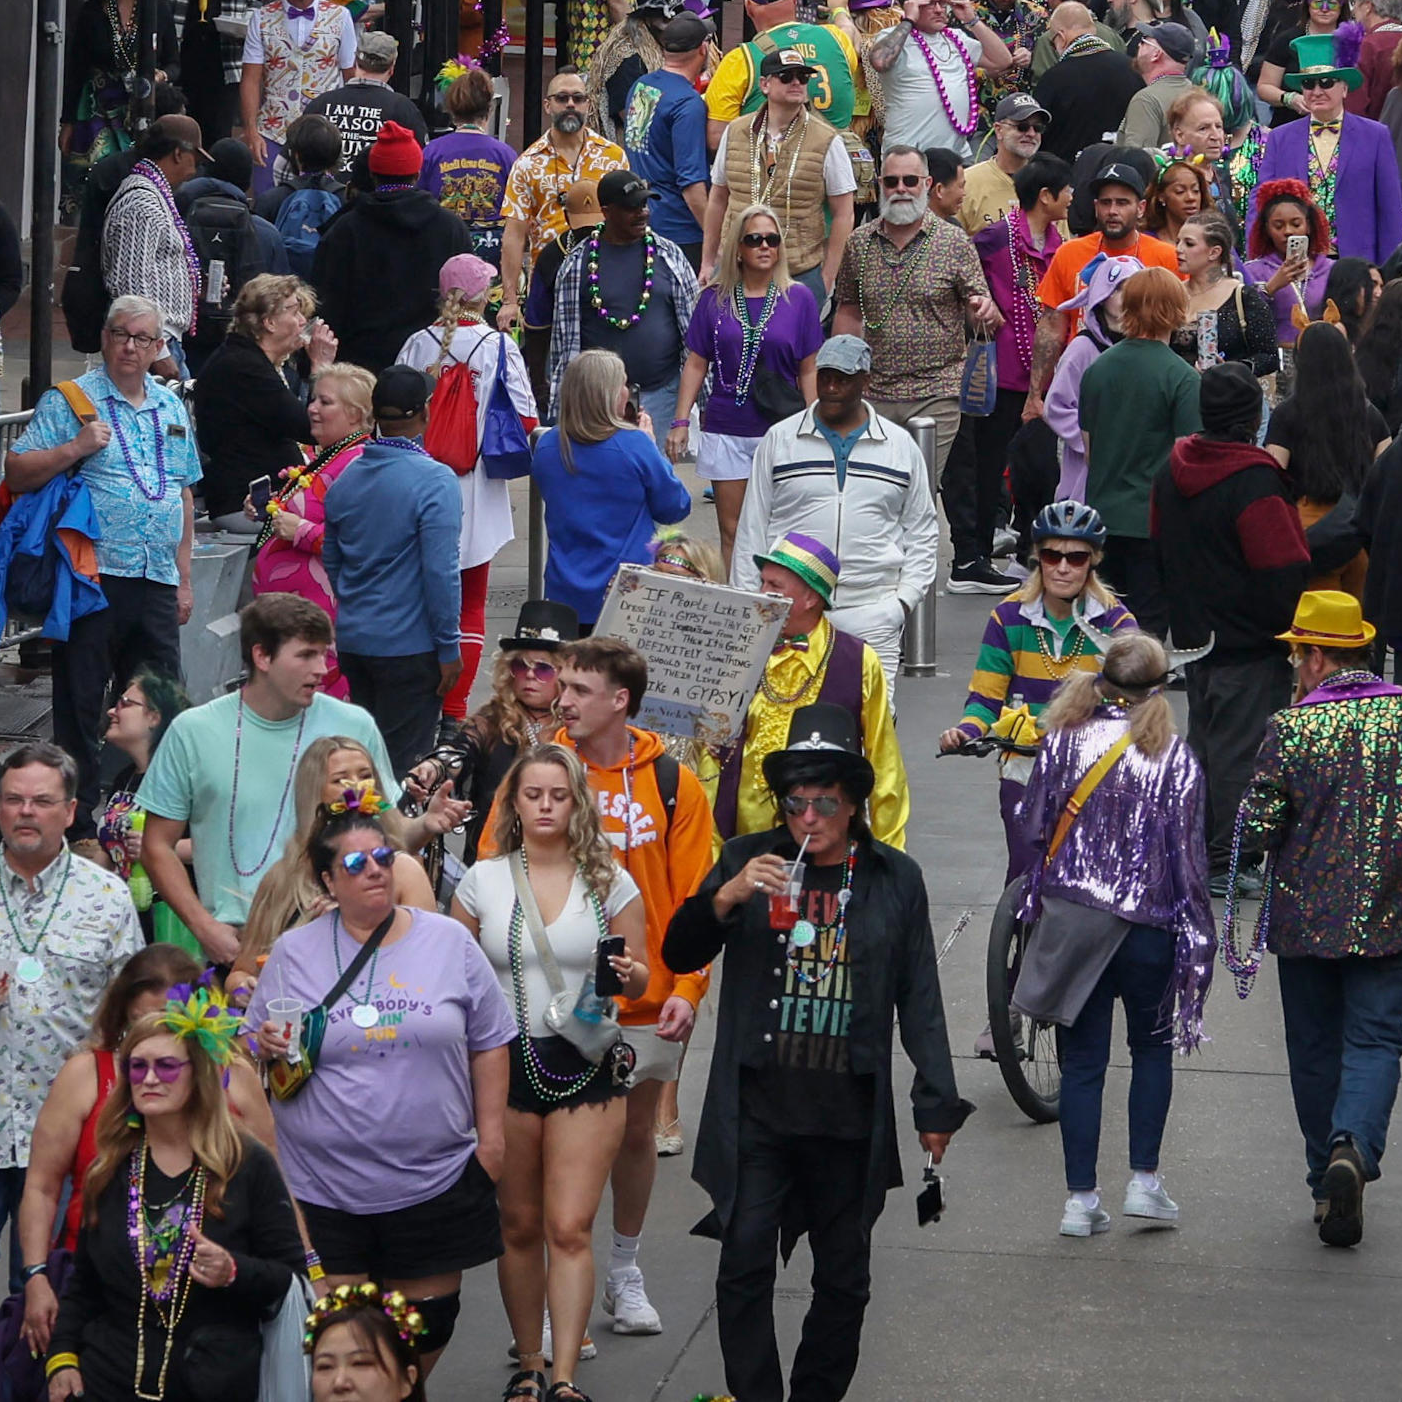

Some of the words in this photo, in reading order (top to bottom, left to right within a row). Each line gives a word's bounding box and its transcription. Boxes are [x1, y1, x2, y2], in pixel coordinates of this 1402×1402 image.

[325, 103, 331, 116] I
[333, 104, 355, 117] AM
[358, 106, 383, 120] THE
[342, 132, 360, 140] THE
[675, 610, 707, 624] GYPSY
[673, 685, 680, 697] A
[686, 684, 746, 713] GYPSY!
[365, 1026, 397, 1042] FUN
